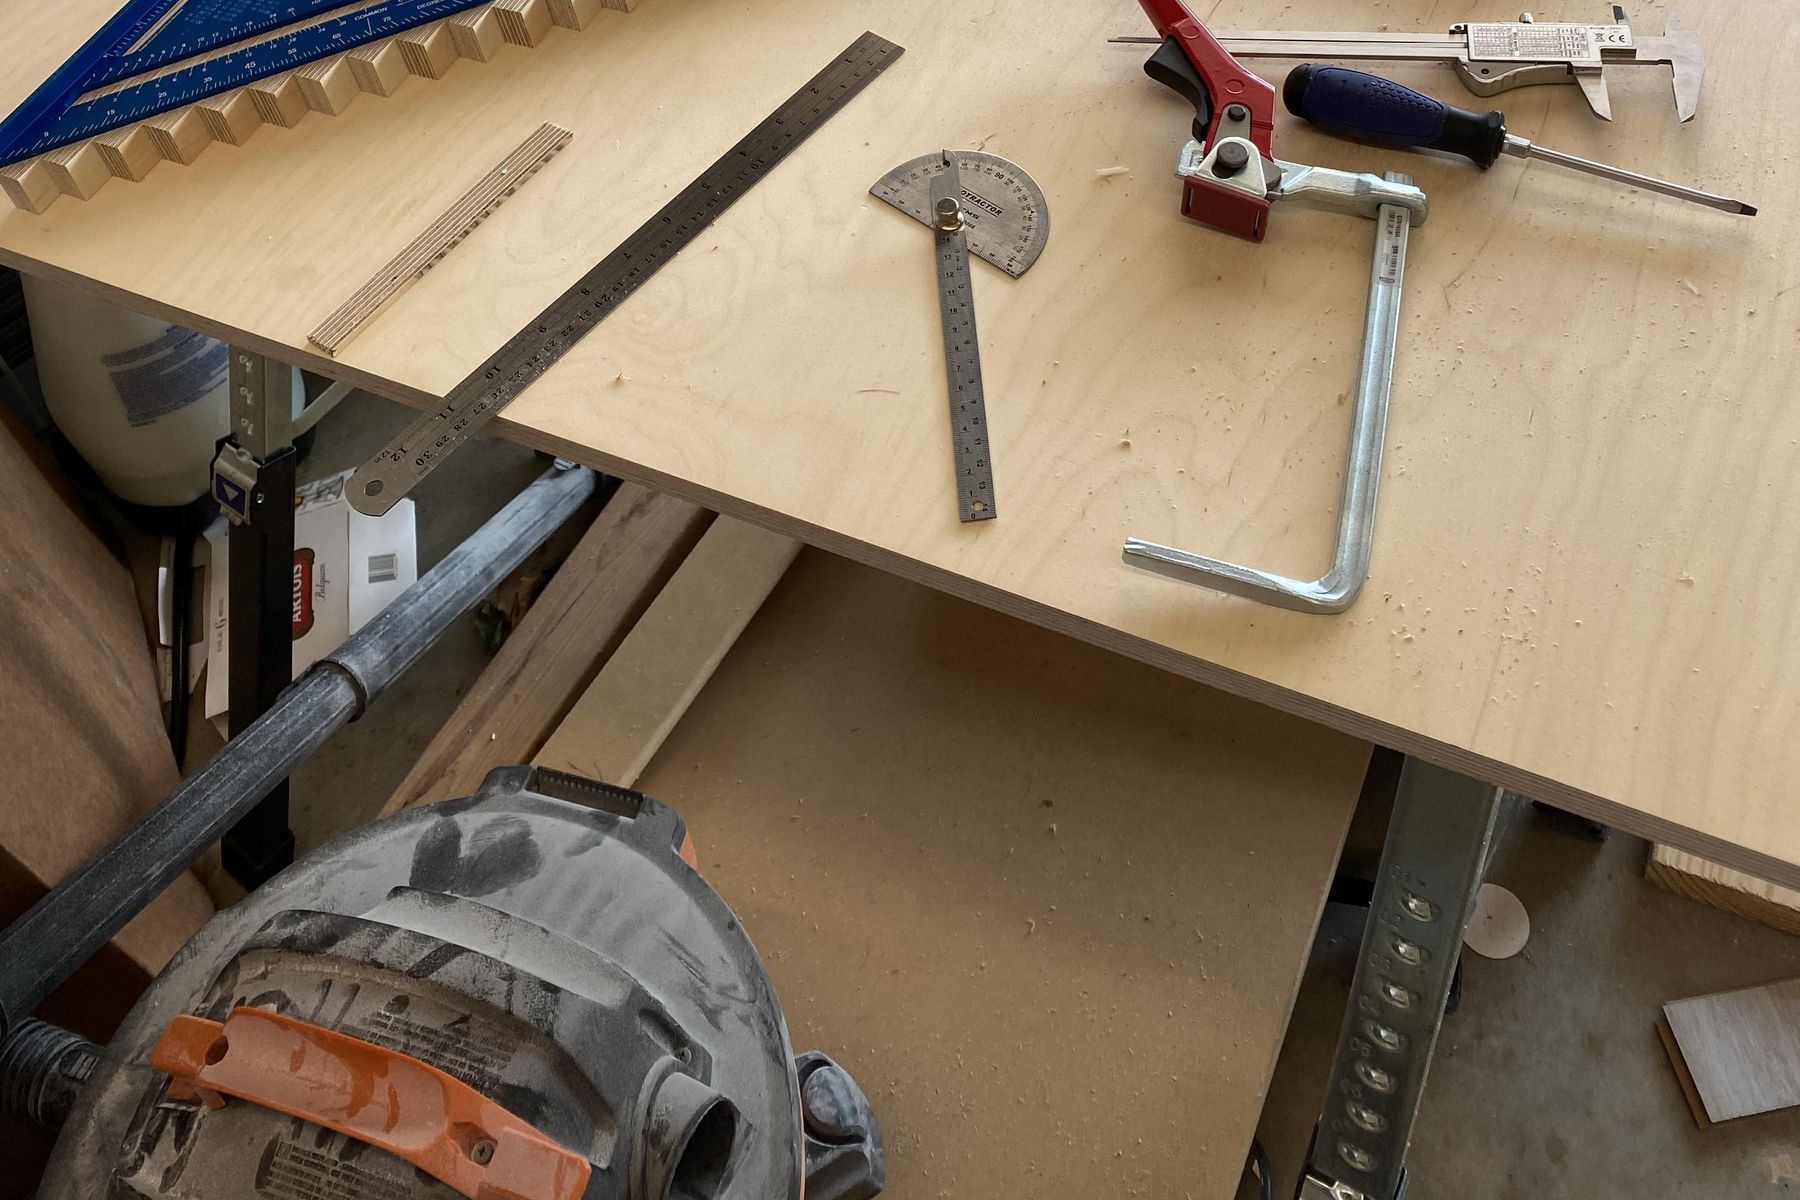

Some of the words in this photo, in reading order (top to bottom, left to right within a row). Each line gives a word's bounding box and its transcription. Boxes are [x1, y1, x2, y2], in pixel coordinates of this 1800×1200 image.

[354, 7, 388, 22] COMMON
[157, 91, 168, 99] 25
[244, 62, 257, 70] 45
[288, 47, 297, 55] 55
[332, 32, 342, 40] 65
[382, 16, 392, 24] 75
[749, 156, 765, 171] 10
[736, 170, 748, 182] 11
[994, 172, 1004, 180] 90
[721, 184, 733, 195] 12
[705, 197, 718, 209] 13
[960, 190, 1003, 216] OTRACTOR
[690, 210, 703, 222] 14
[674, 224, 687, 236] 15
[658, 238, 671, 250] 16
[622, 250, 631, 259] 7
[643, 252, 656, 264] 17
[626, 266, 640, 279] 18
[579, 286, 590, 296] 8
[610, 280, 624, 293] 19
[593, 292, 610, 309] 20
[578, 309, 591, 321] 21
[537, 323, 547, 334] 9
[560, 324, 574, 337] 22
[542, 338, 557, 353] 23
[525, 354, 539, 368] 24
[483, 364, 500, 380] 10
[507, 369, 522, 384] 25
[490, 386, 504, 399] 26
[438, 404, 455, 420] 11
[471, 401, 486, 416] 27
[452, 417, 468, 432] 28
[434, 434, 449, 448] 29
[389, 444, 408, 462] 12
[414, 449, 433, 467] 30
